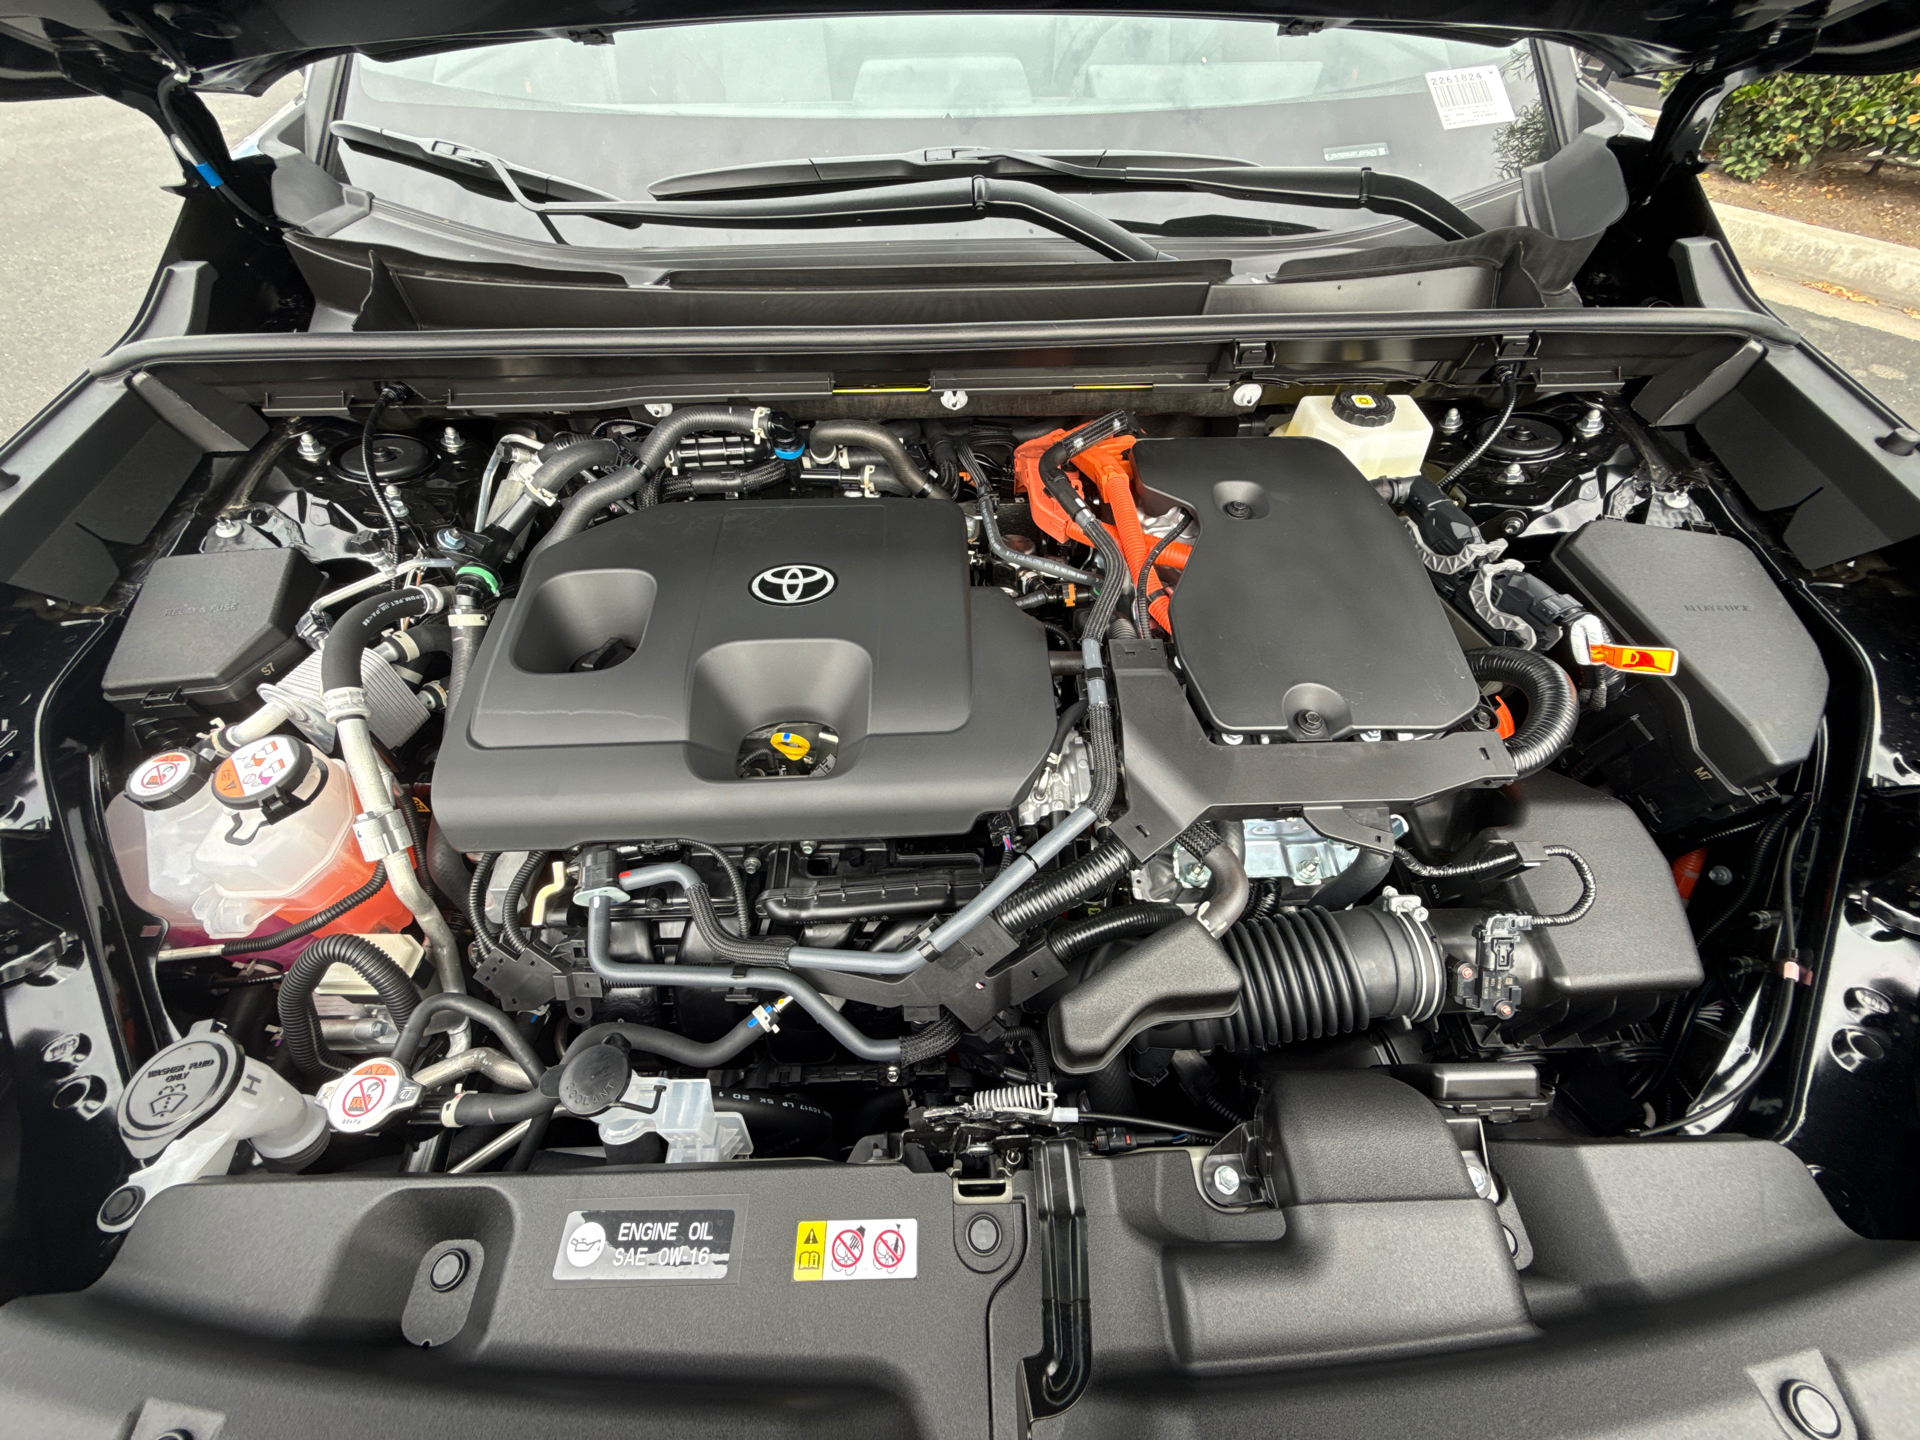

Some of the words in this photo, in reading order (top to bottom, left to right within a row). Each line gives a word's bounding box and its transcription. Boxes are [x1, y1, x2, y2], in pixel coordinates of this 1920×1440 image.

[1431, 72, 1482, 86] 2261824
[211, 602, 239, 612] FUSE
[261, 662, 276, 676] S7
[1694, 766, 1713, 780] M7
[147, 1064, 185, 1078] WASHER
[188, 1059, 215, 1070] FLUID
[165, 1072, 190, 1082] ONLY
[566, 1082, 615, 1106] COOLANT
[617, 1222, 679, 1241] ENGINE
[688, 1222, 714, 1240] OIL
[612, 1247, 648, 1266] SAE
[658, 1247, 710, 1266] 0W-16
